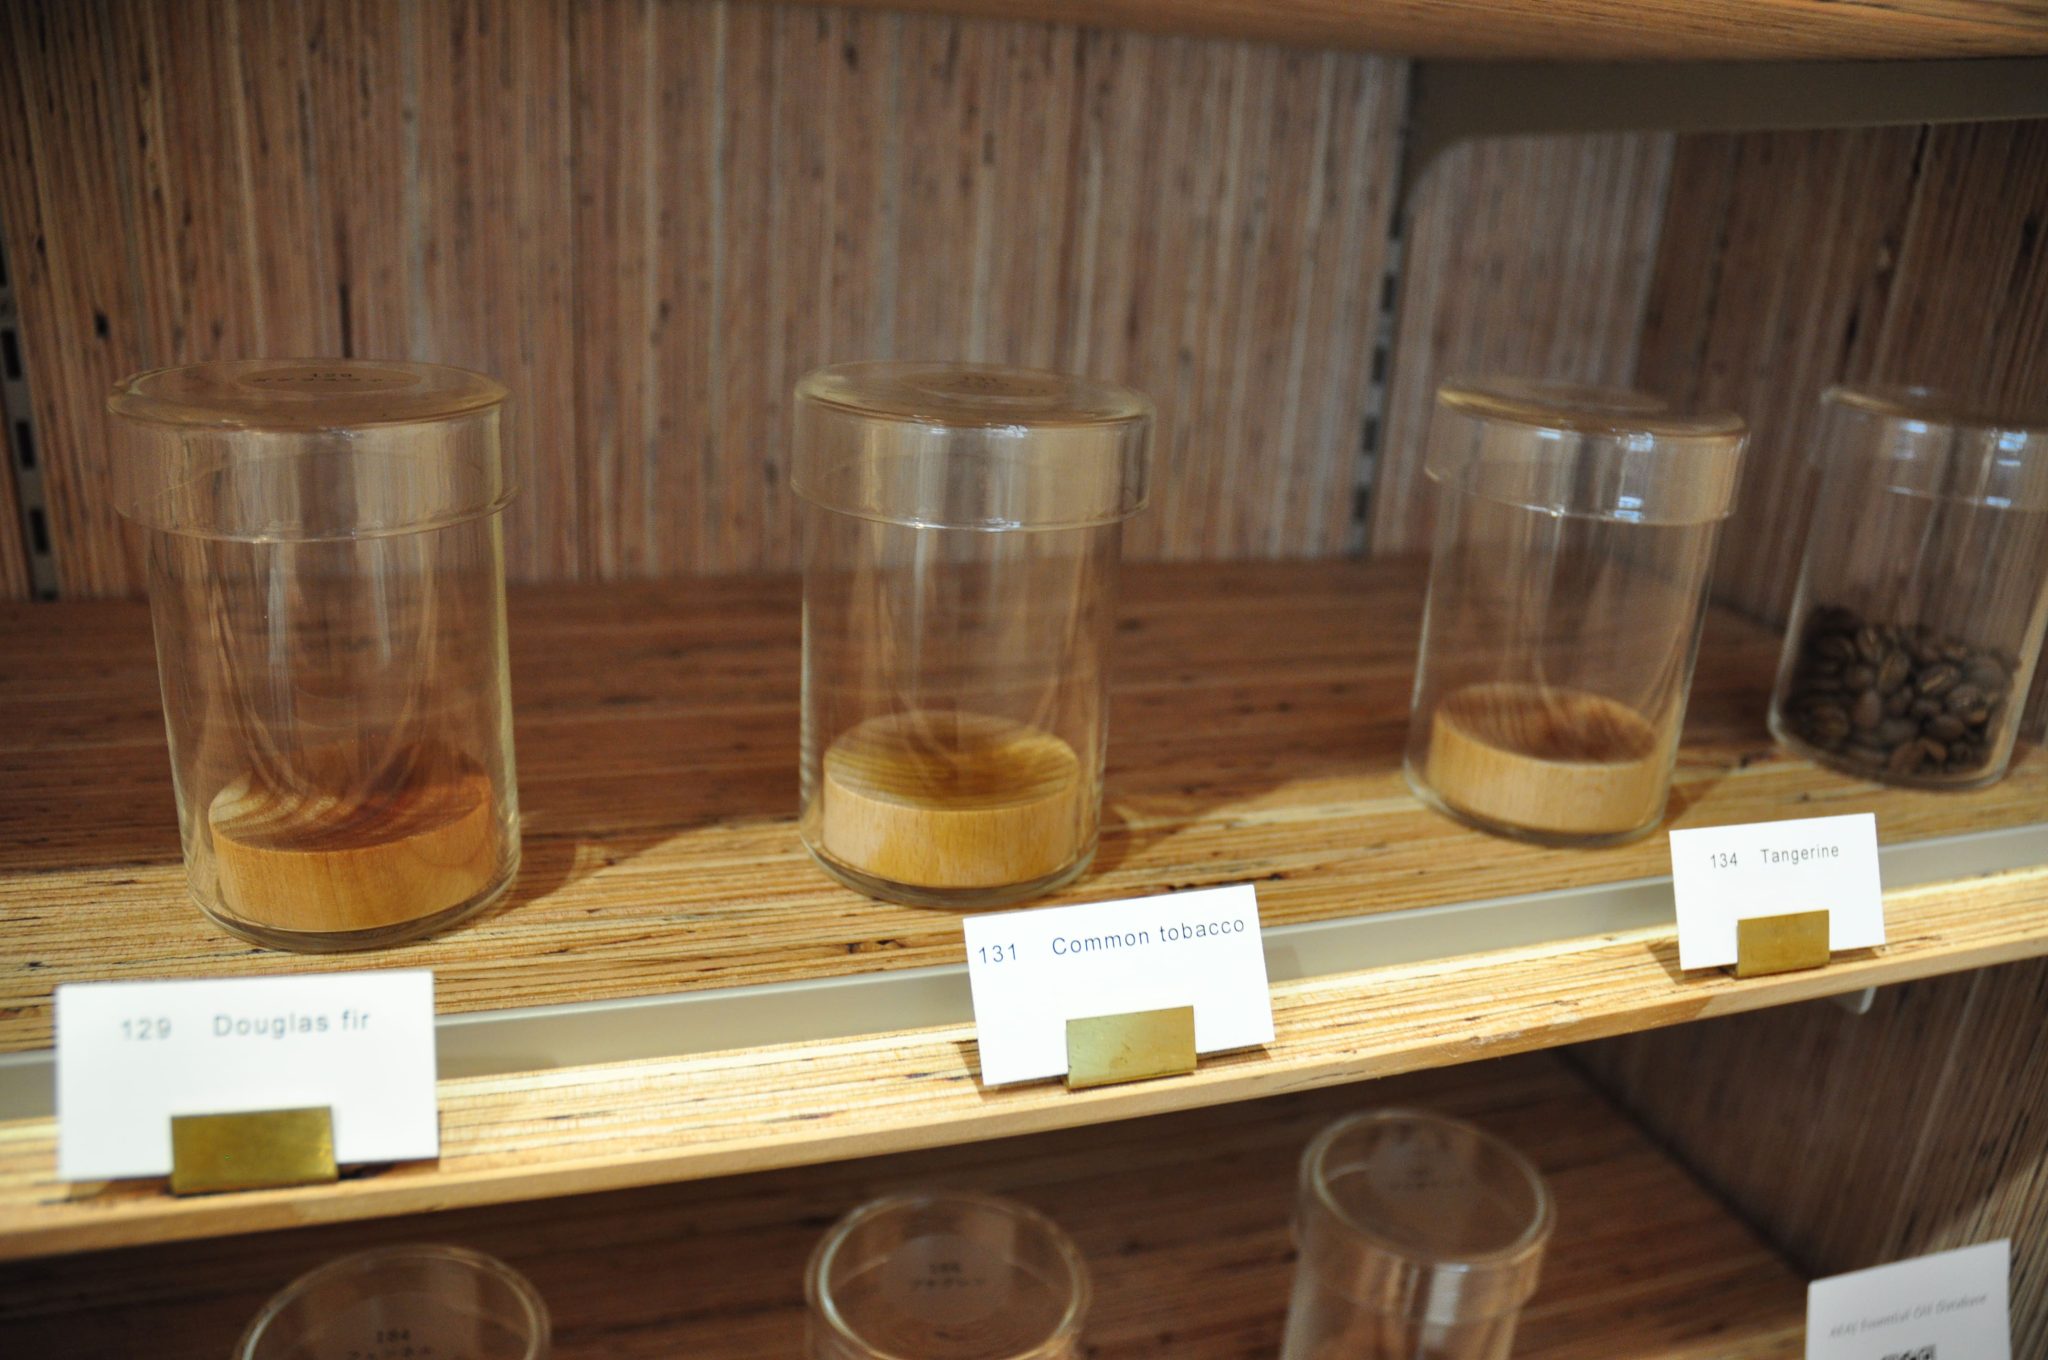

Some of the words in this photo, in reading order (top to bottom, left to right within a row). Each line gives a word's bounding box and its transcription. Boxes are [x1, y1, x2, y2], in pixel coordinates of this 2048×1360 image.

[1711, 853, 1738, 868] 134
[1760, 845, 1840, 865] Tangerine
[978, 944, 1017, 964] 131
[1052, 929, 1149, 956] Common
[1160, 918, 1245, 943] tobacco
[122, 1018, 172, 1040] 129
[213, 1014, 329, 1039] Douglas
[342, 1009, 370, 1030] fir
